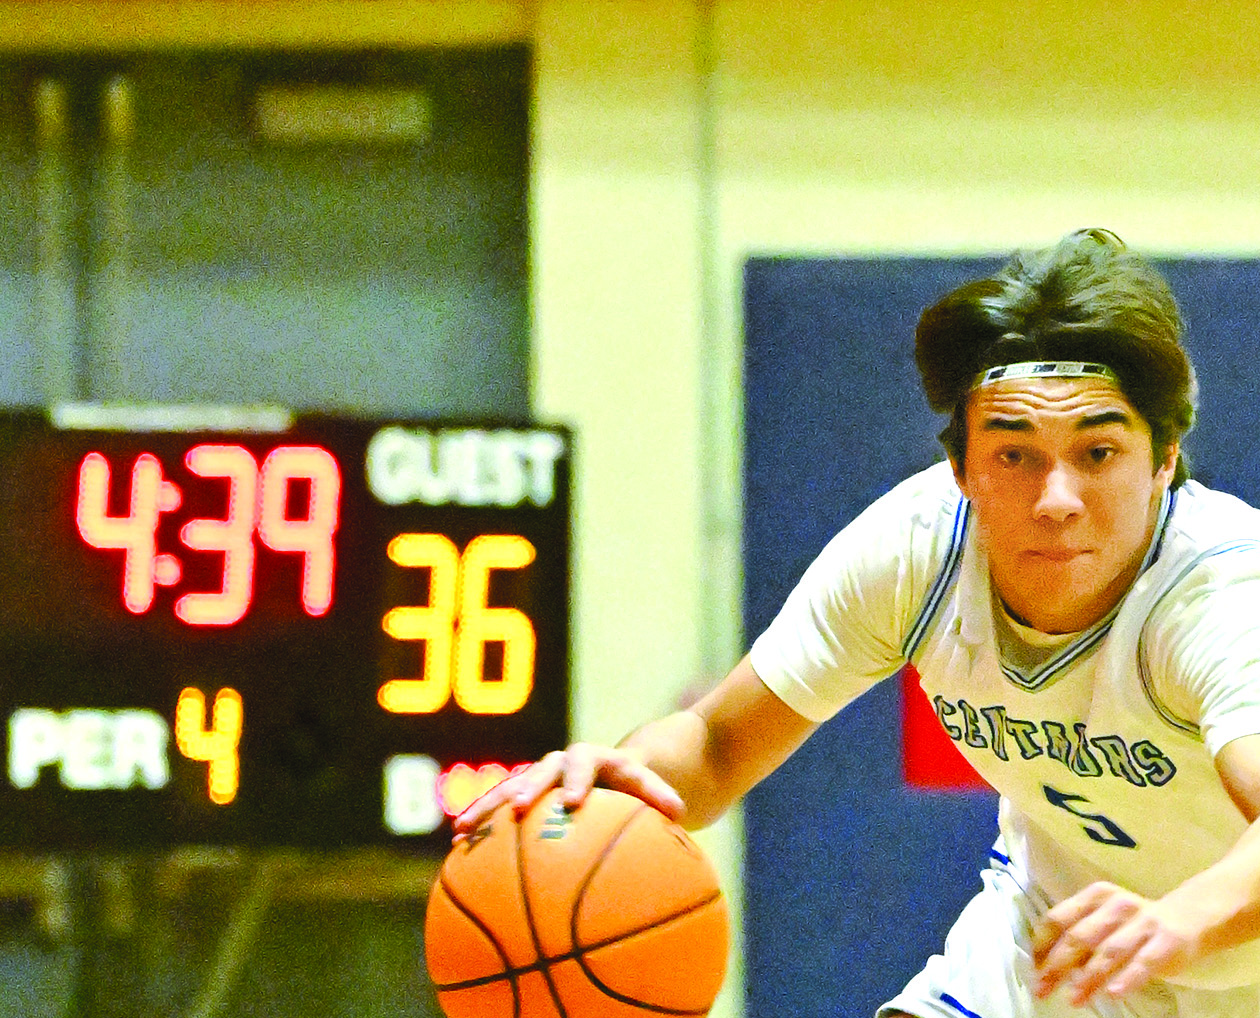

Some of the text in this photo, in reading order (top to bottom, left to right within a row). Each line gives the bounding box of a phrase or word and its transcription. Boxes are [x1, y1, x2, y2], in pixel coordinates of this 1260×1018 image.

[77, 445, 341, 625] 4:39
[366, 427, 562, 506] GUEST
[378, 533, 536, 714] 36
[8, 688, 243, 804] PER 4
